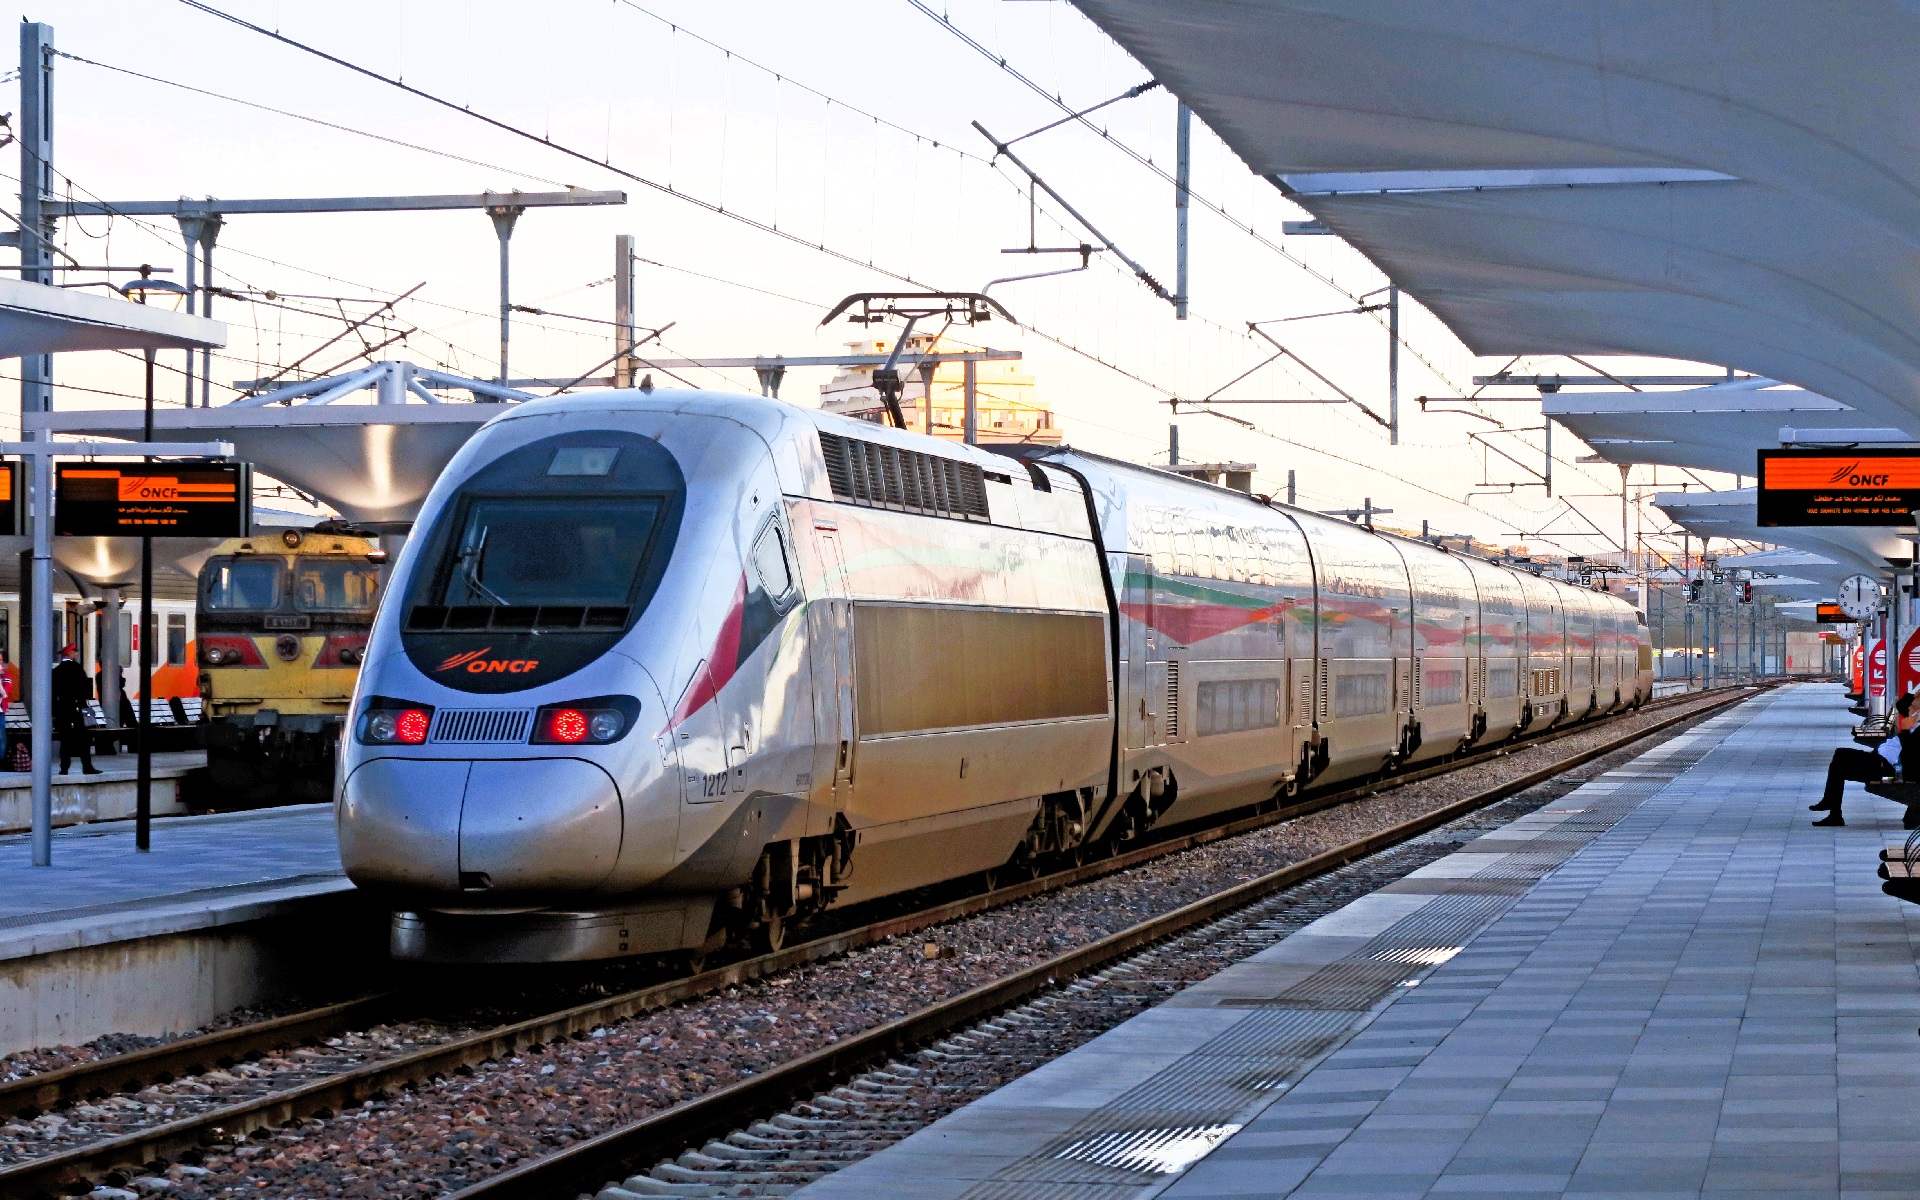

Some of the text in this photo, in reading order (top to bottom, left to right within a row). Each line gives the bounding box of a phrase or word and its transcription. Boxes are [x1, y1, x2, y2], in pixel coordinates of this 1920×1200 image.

[1849, 474, 1888, 486] ONCF
[140, 487, 177, 498] ONCF
[466, 660, 539, 673] ONCF
[702, 771, 728, 797] 1212
